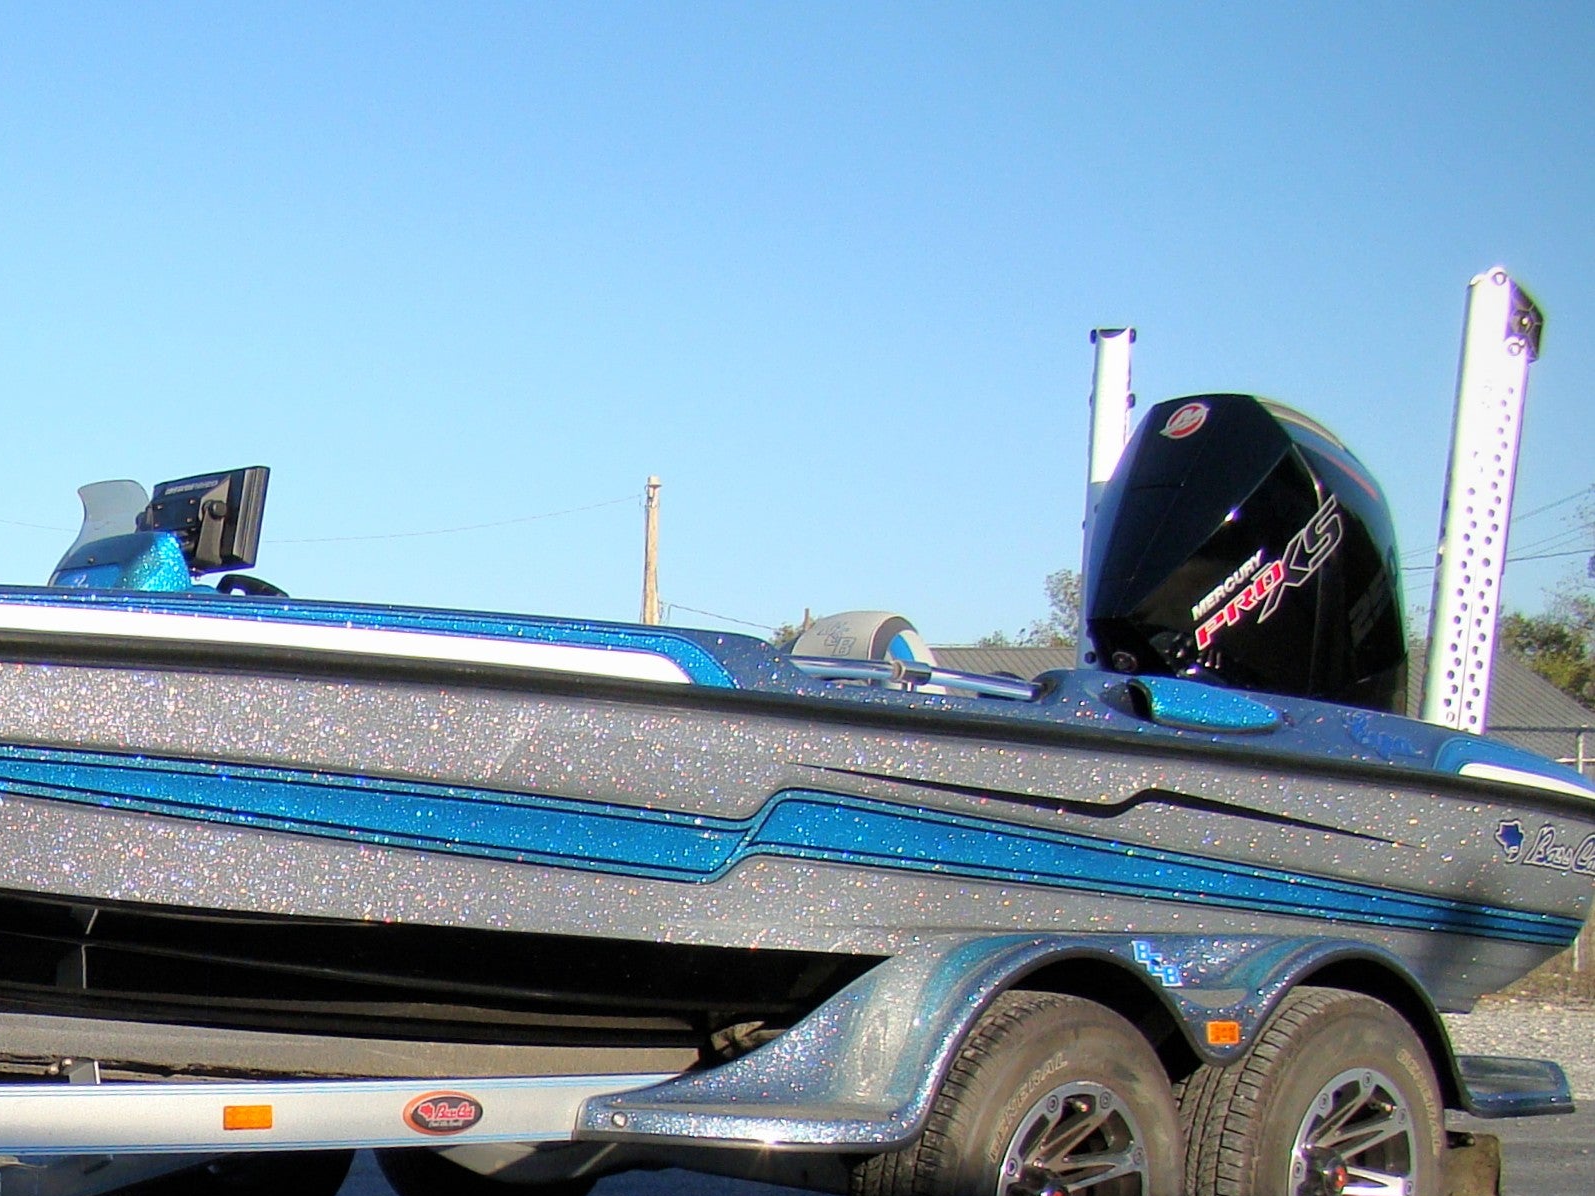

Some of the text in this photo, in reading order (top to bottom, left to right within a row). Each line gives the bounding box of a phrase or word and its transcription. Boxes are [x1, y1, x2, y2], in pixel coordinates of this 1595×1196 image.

[1191, 548, 1264, 621] MERCURY
[1194, 494, 1343, 651] PRO XS
[1522, 824, 1573, 870] Bass
